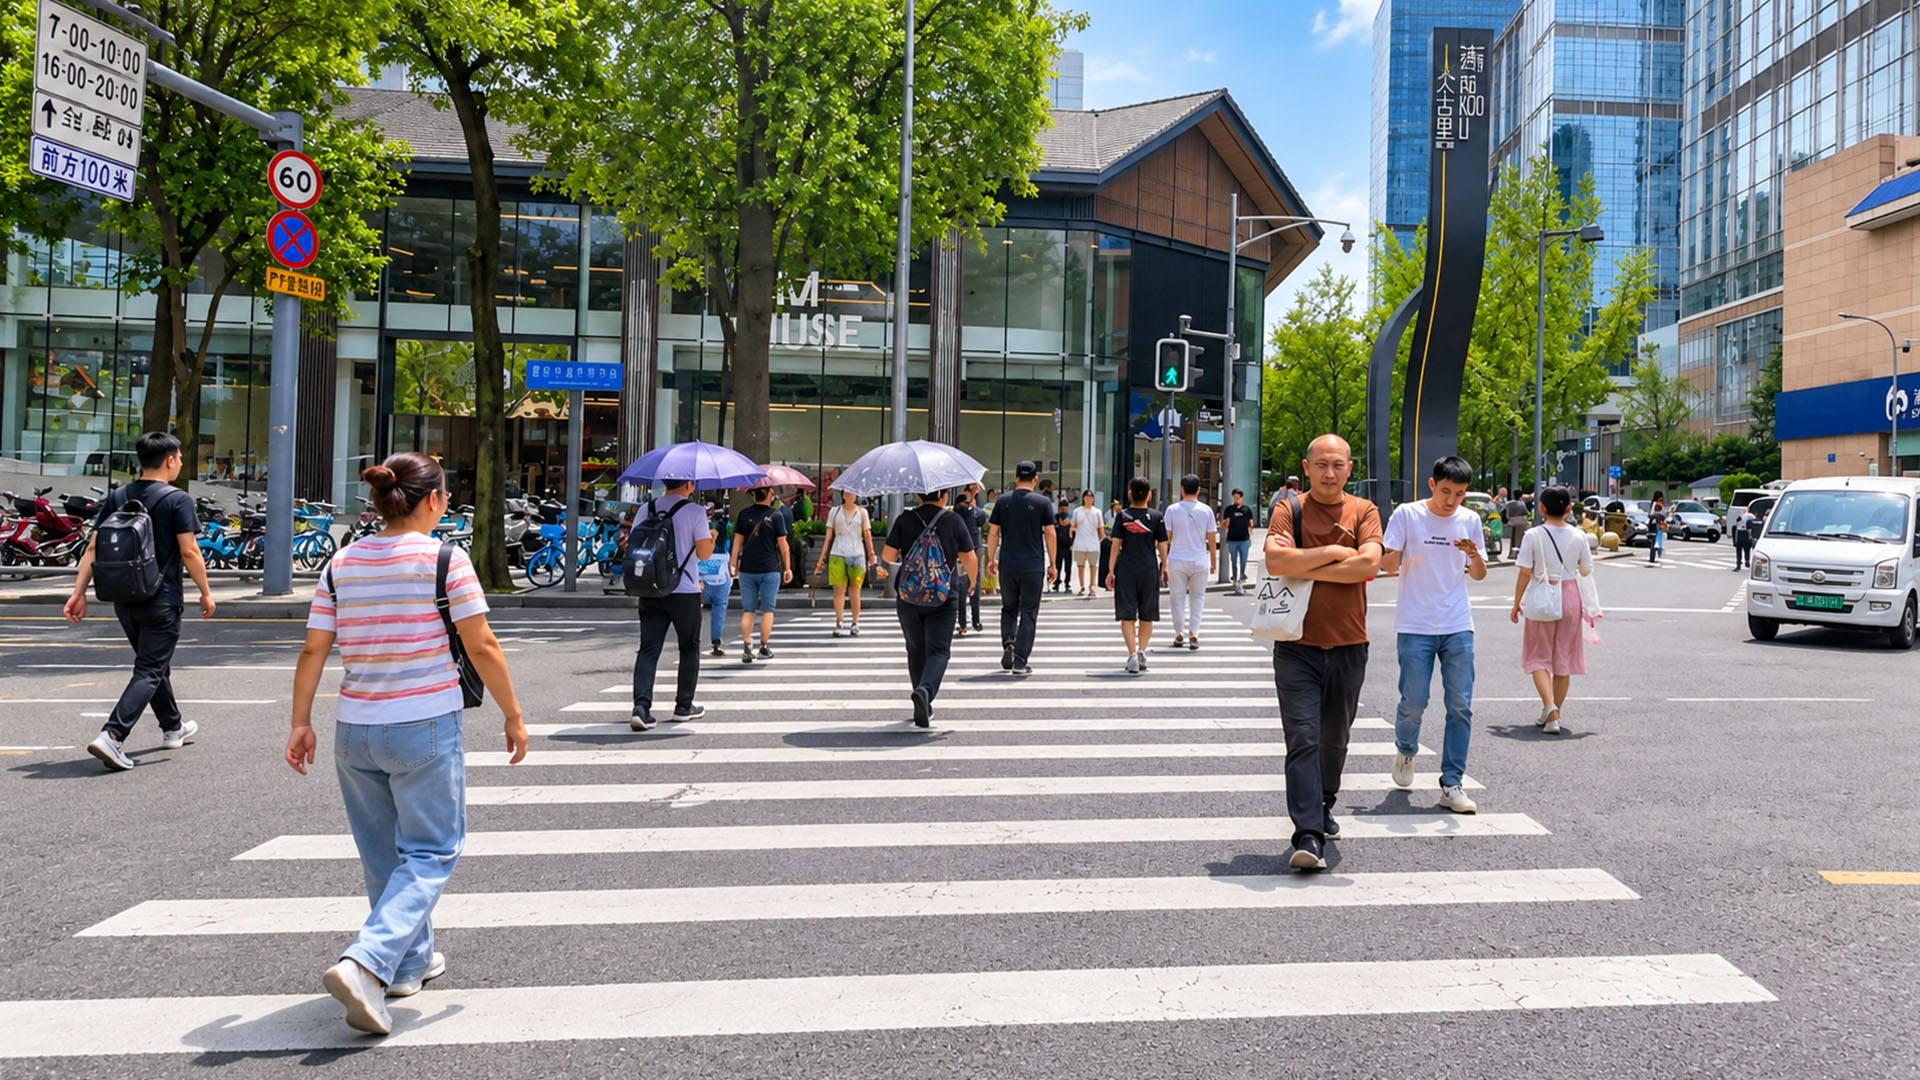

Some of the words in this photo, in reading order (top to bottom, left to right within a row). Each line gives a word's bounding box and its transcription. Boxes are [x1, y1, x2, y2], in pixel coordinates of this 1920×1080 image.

[42, 52, 138, 110] 16:00-20:00
[1459, 95, 1485, 117] KOO
[42, 145, 128, 193] 前方100米
[279, 166, 312, 193] 60
